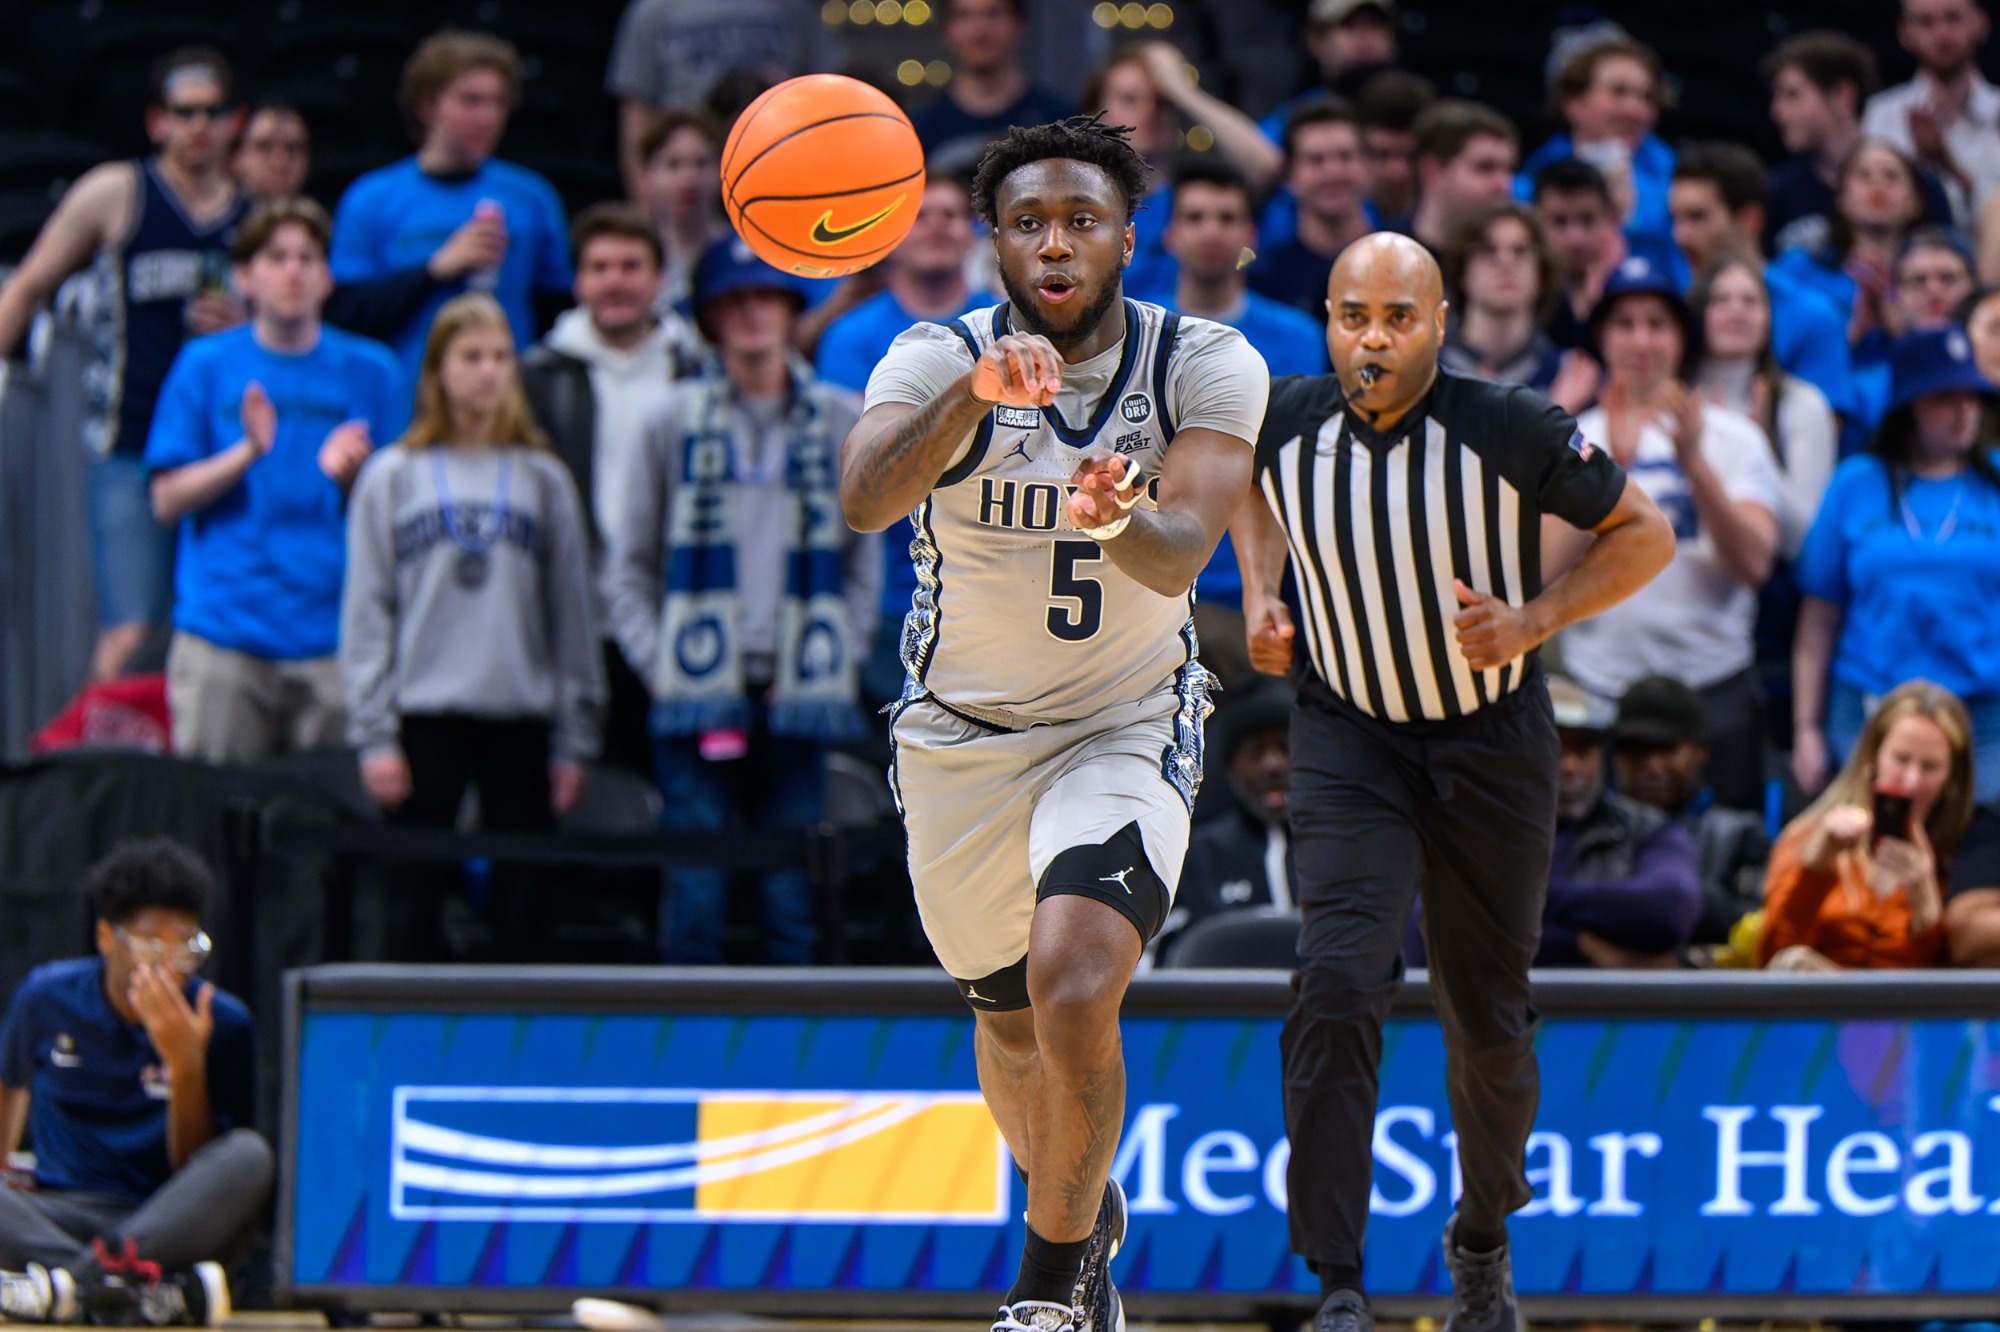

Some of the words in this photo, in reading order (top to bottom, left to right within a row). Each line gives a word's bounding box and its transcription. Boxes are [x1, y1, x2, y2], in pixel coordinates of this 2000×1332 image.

[1124, 397, 1147, 407] LOUIS
[1125, 404, 1148, 419] ORR
[998, 416, 1039, 427] CHANGE
[1114, 437, 1152, 453] EAST
[1116, 430, 1142, 447] BIG
[1044, 539, 1104, 643] 5
